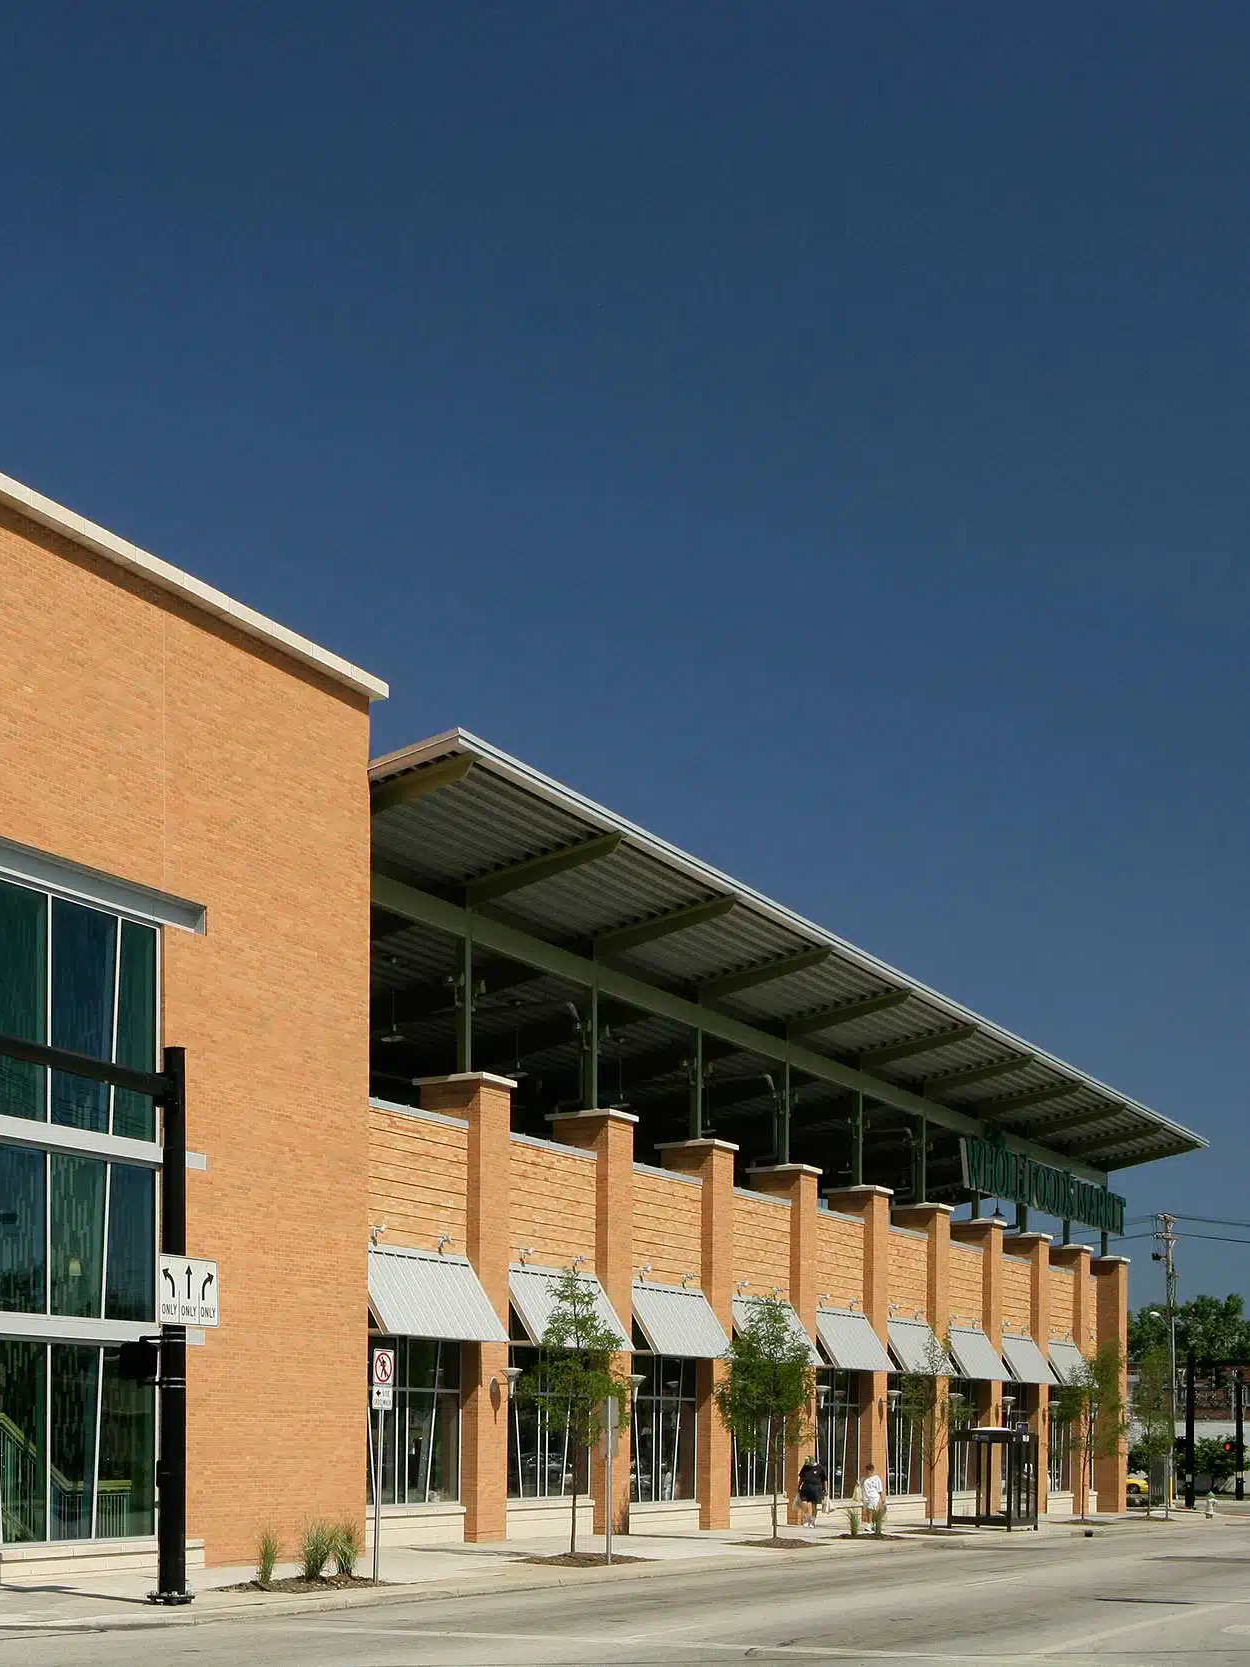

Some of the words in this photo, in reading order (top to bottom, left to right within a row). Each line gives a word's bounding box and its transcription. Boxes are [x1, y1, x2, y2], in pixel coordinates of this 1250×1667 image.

[162, 1303, 177, 1316] ONLY
[181, 1305, 197, 1317] ONLY
[200, 1307, 216, 1319] ONLY
